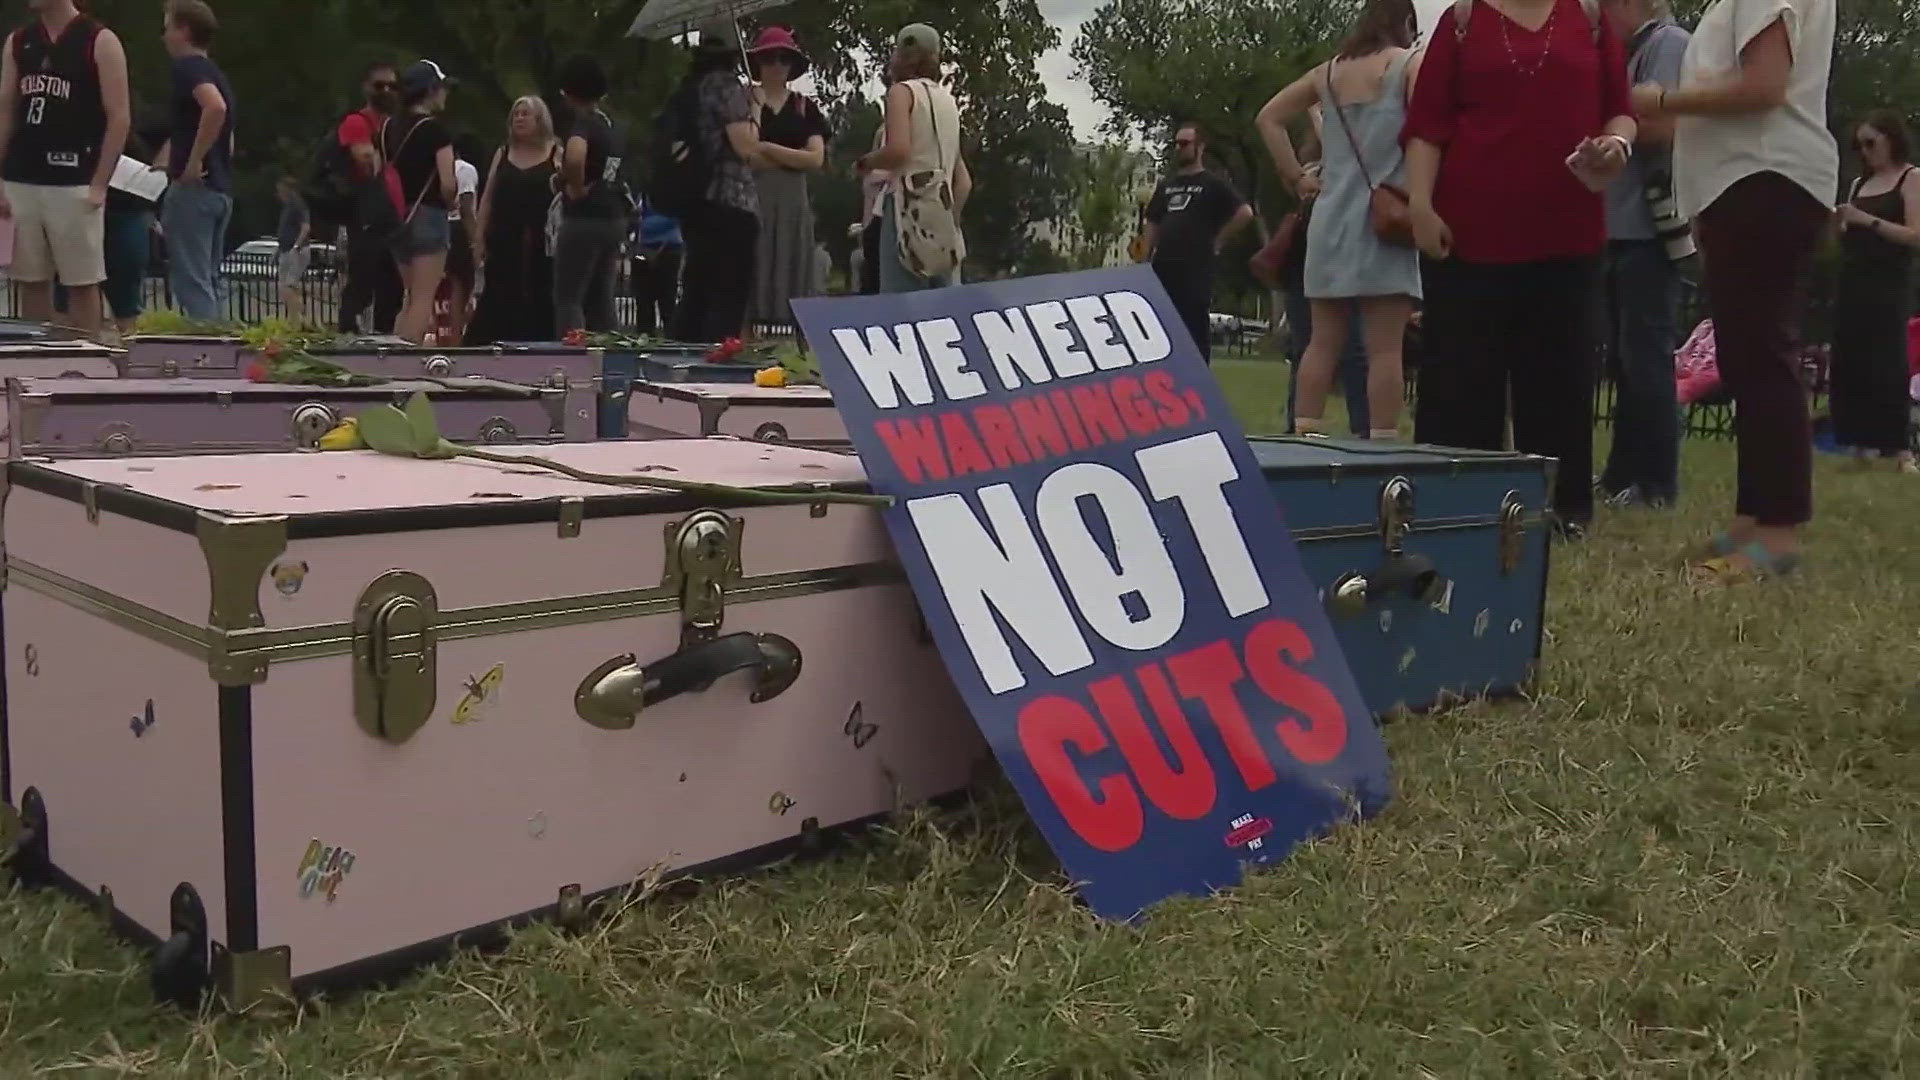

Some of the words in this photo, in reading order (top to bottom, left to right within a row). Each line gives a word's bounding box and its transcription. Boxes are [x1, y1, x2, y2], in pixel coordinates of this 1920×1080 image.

[26, 96, 46, 125] 13
[831, 317, 988, 410] WE
[971, 290, 1172, 391] NEED
[873, 370, 1206, 485] WARNINGS,
[906, 430, 1270, 695] NOT
[1017, 618, 1349, 853] CUTS
